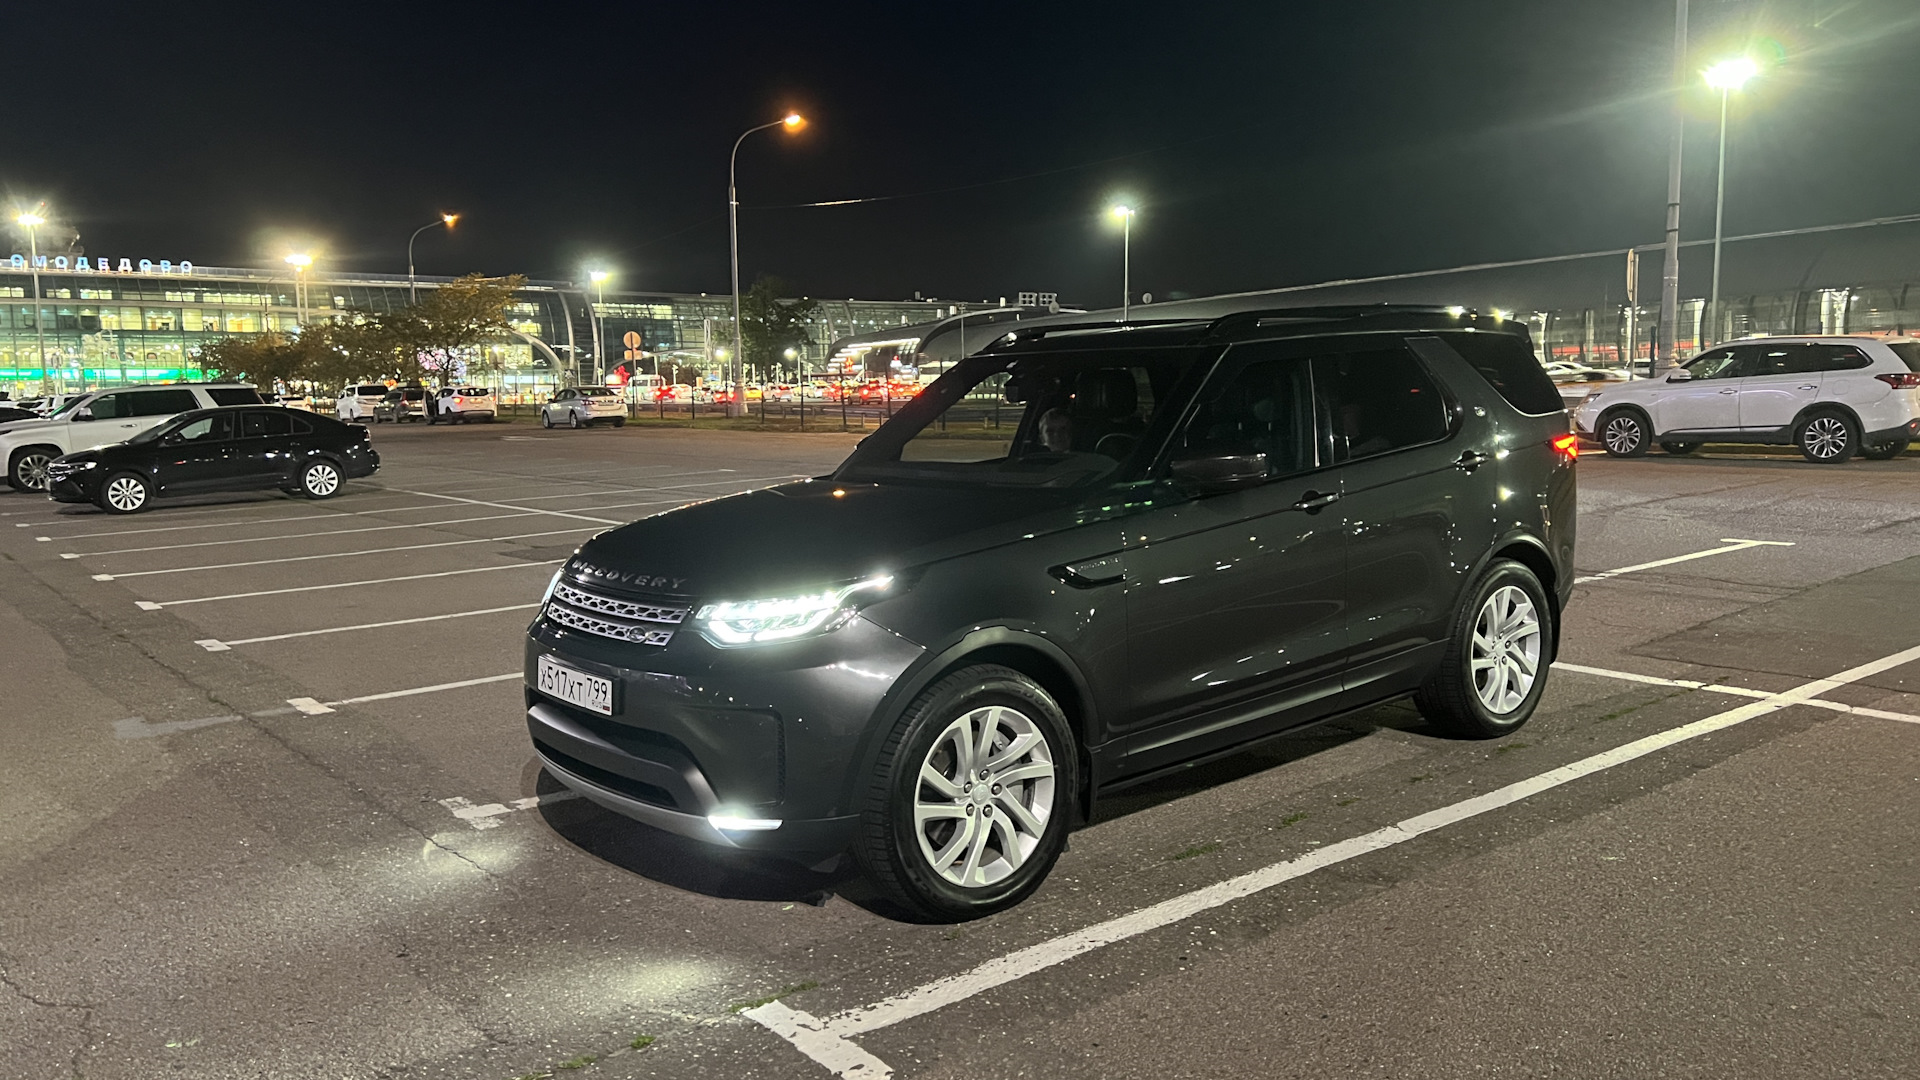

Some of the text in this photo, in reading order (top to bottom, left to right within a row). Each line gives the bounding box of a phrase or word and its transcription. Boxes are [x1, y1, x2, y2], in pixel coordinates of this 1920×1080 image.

[9, 253, 194, 273] ОМОДЕДОВО
[571, 559, 687, 589] DISCOVERY
[586, 677, 608, 702] 799
